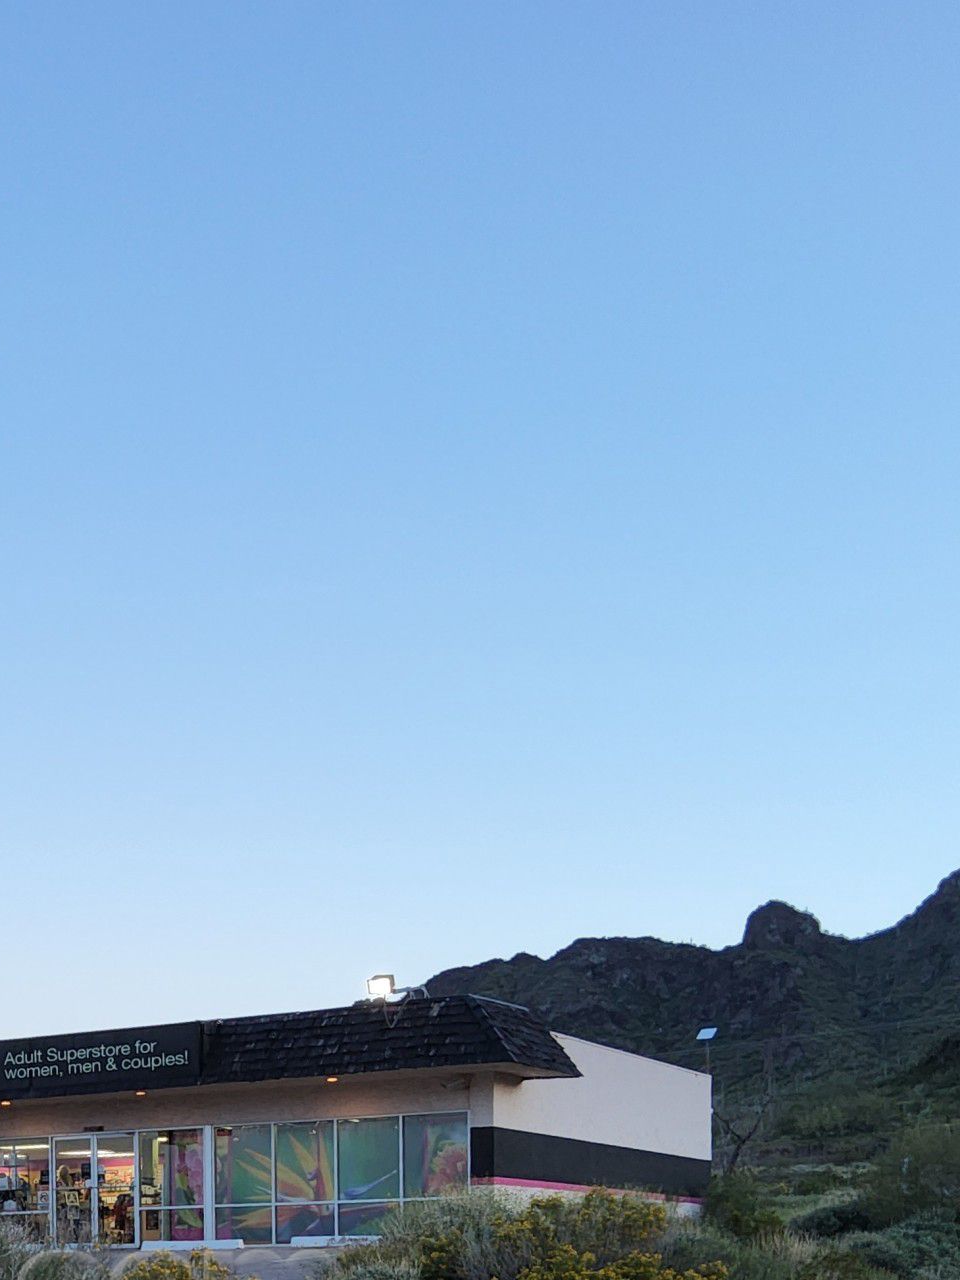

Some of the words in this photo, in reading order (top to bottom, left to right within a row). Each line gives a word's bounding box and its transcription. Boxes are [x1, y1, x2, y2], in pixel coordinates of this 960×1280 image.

[4, 1049, 43, 1066] Adult
[46, 1043, 131, 1064] Superstore
[134, 1040, 157, 1055] for
[4, 1064, 63, 1079] women,
[68, 1061, 101, 1075] men
[105, 1057, 118, 1071] &
[121, 1050, 189, 1071] couples!
